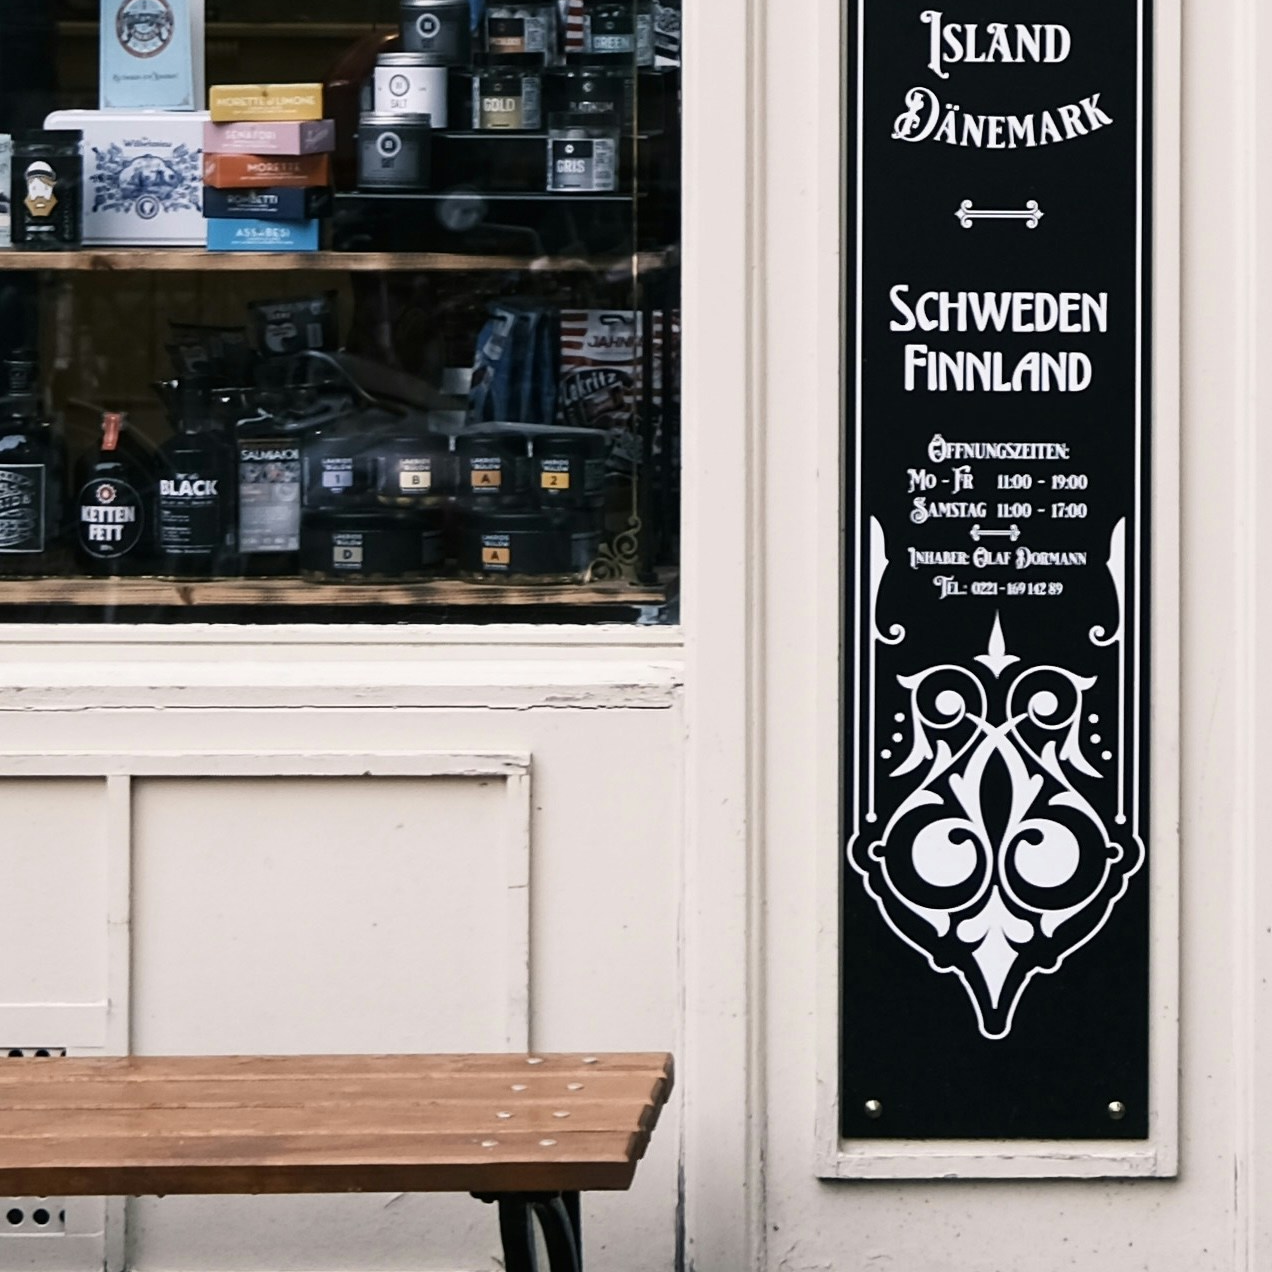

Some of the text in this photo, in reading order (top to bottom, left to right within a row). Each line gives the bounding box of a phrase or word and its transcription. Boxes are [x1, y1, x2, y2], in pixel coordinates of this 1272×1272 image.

[920, 10, 1071, 79] ISLAND
[483, 98, 516, 112] GOLD
[891, 87, 1113, 148] DÄNEMARK
[556, 159, 586, 173] GRIS
[890, 285, 1108, 332] SCHWEDEN
[904, 344, 1092, 392] FINNLAND
[159, 479, 218, 496] BLACK
[997, 474, 1032, 489] 11:00
[1052, 474, 1088, 489] 19:00
[81, 506, 136, 522] KETTEN
[910, 497, 987, 524] SAMSTAG
[997, 503, 1032, 518] 11:00
[1052, 503, 1087, 518] 17:00
[88, 525, 124, 541] FETT
[973, 547, 1011, 568] OLAF
[1016, 547, 1087, 569] DORMANN
